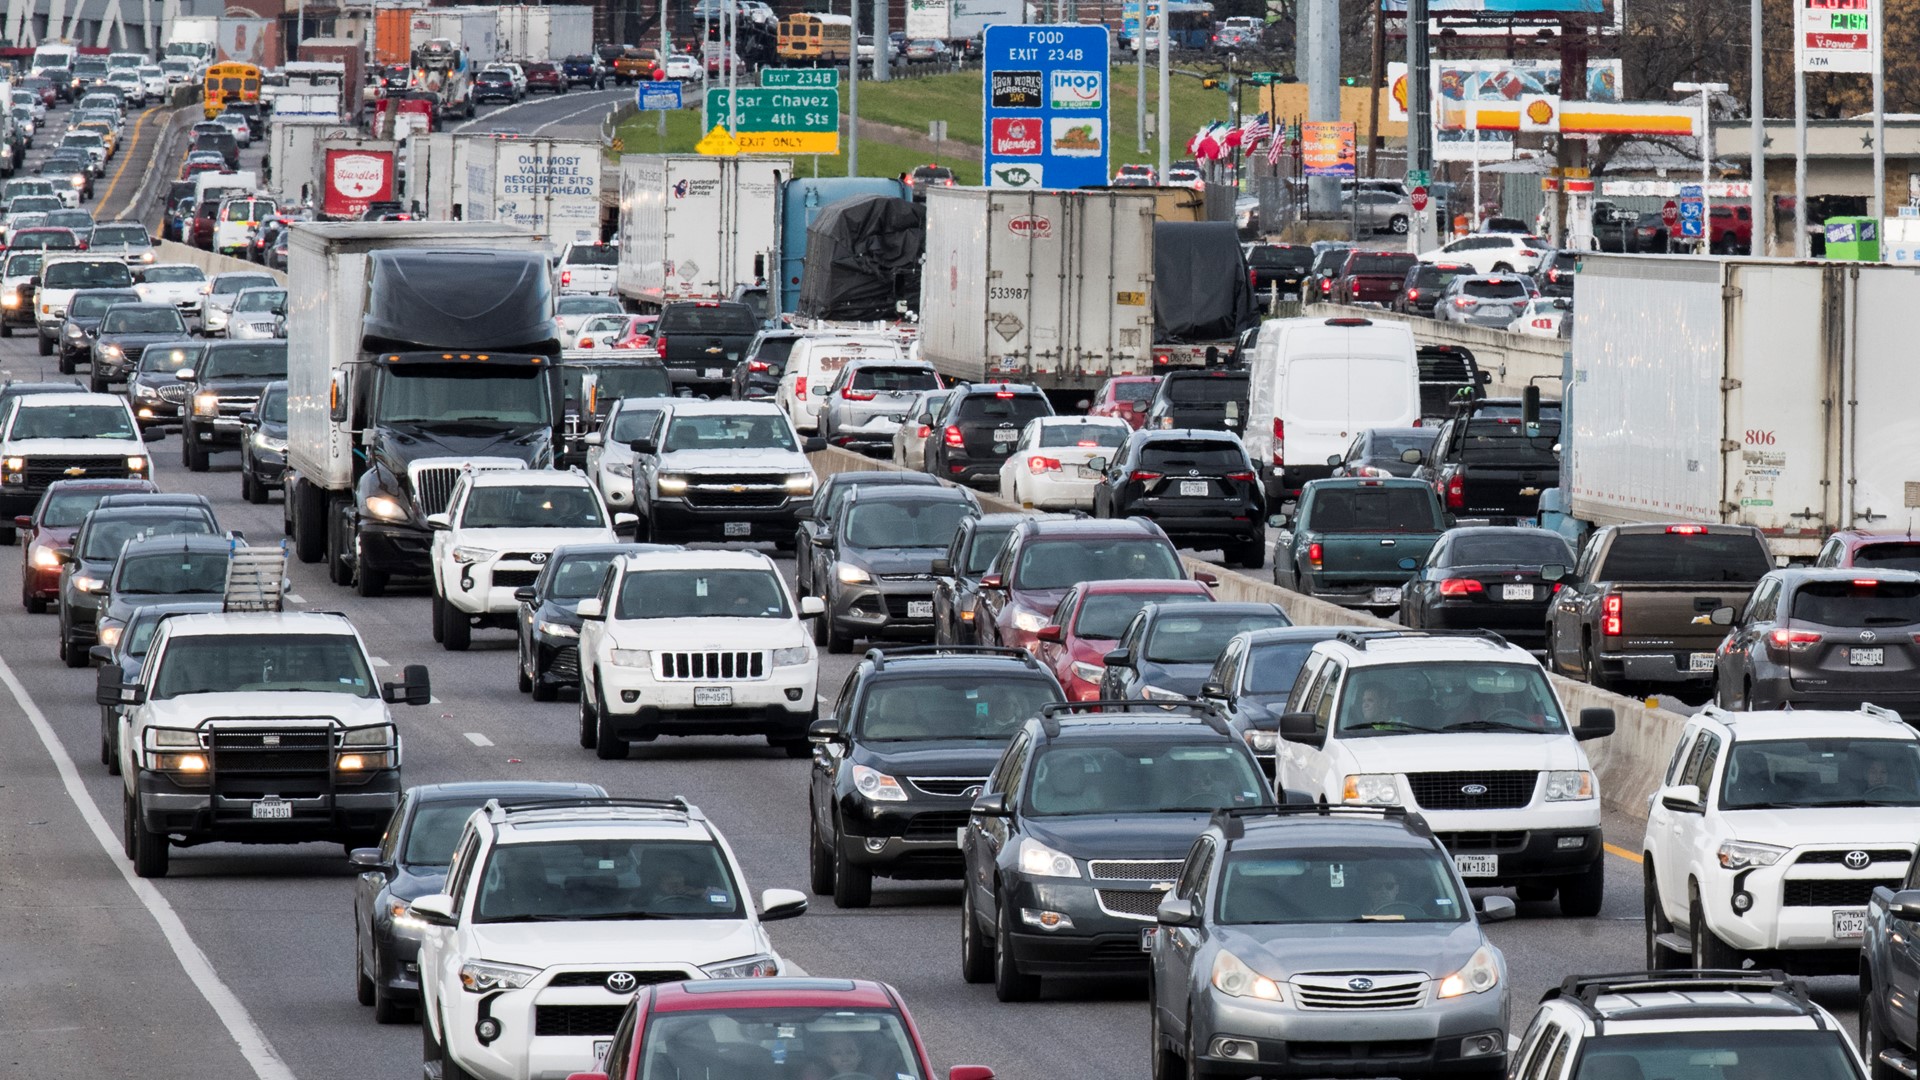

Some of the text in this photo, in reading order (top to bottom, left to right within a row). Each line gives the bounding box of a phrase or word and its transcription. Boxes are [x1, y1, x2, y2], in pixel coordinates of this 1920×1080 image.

[1029, 31, 1064, 44] FOOD
[1009, 48, 1083, 61] EXIT 234B
[769, 72, 831, 84] EXIT 234B
[717, 95, 829, 107] Csar Chavez
[771, 113, 796, 125] 4th
[805, 113, 829, 125] Sts
[740, 137, 766, 147] EXIT
[773, 137, 804, 147] ONLY
[998, 138, 1036, 152] Wendy's
[518, 155, 580, 165] OUR MOST
[520, 166, 579, 175] VALUABLE
[504, 175, 594, 186] RESOURCE SITS
[521, 185, 547, 194] FEET
[1662, 207, 1677, 218] STOP
[1011, 219, 1050, 230] amc
[990, 286, 1029, 300] 533987
[1745, 429, 1776, 445] 806
[1837, 920, 1863, 931] KSD-2
